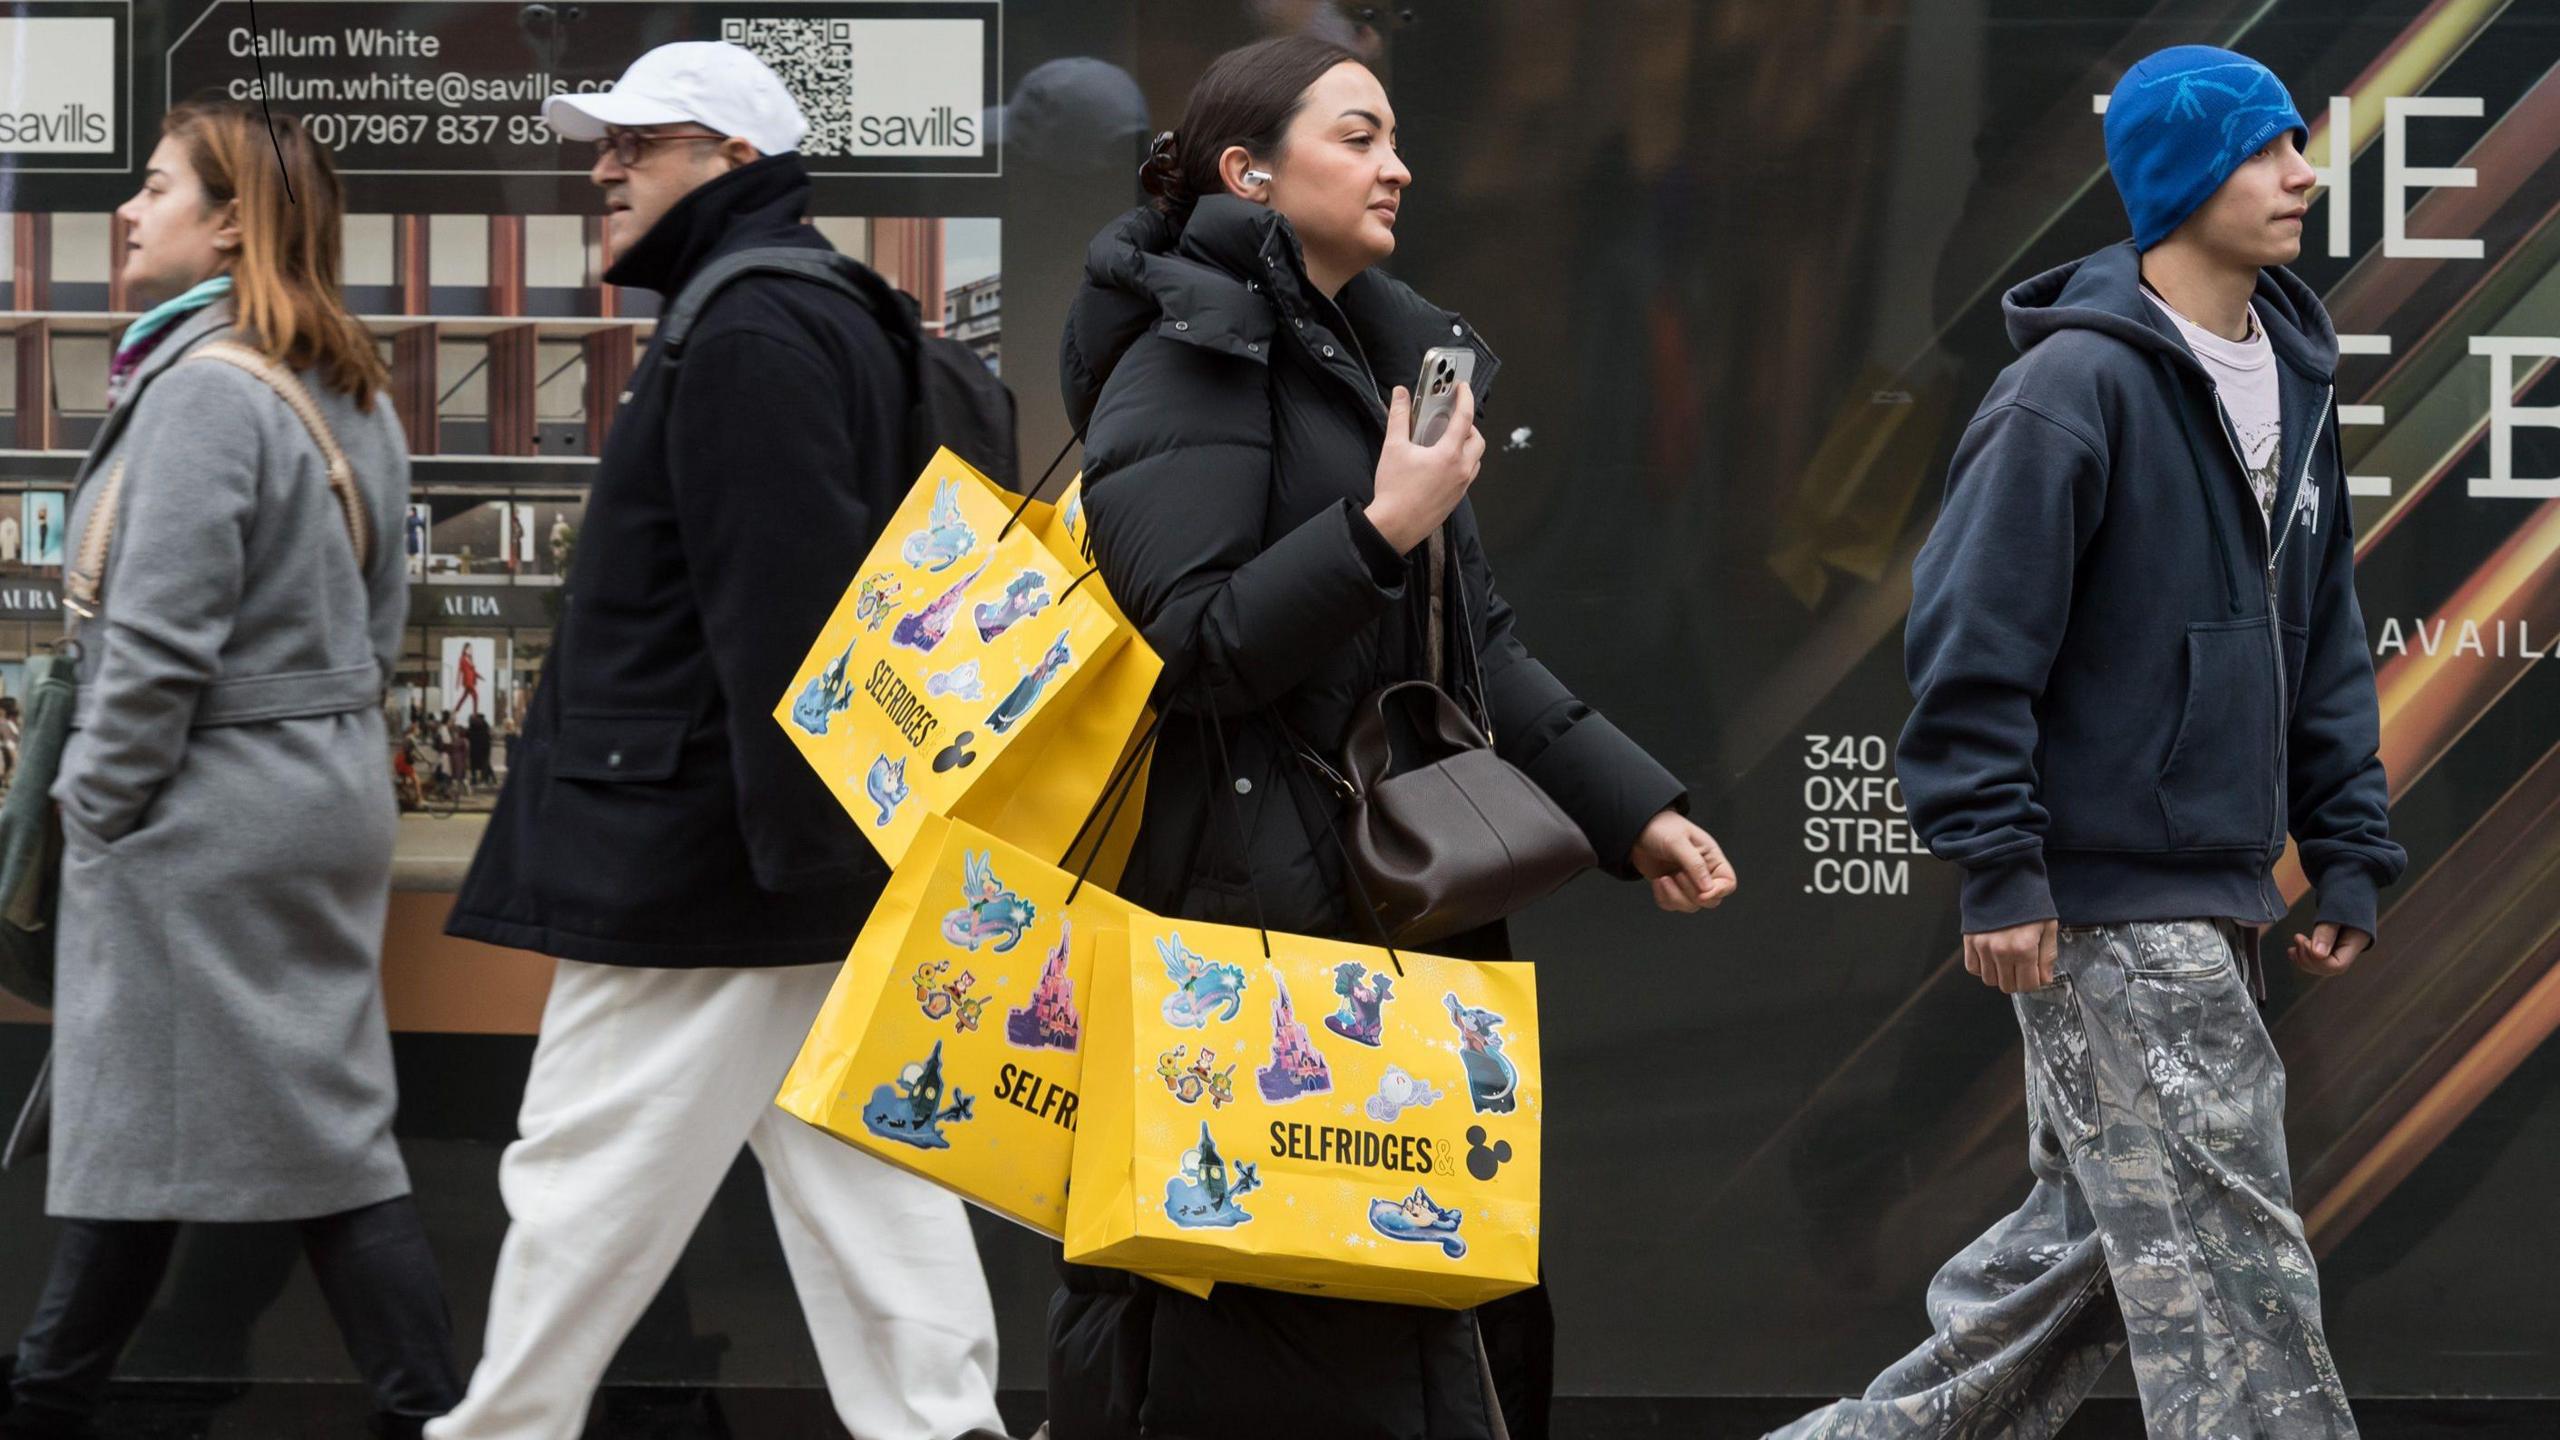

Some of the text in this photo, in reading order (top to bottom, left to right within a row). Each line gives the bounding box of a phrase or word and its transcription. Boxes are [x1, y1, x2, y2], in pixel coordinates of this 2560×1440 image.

[228, 27, 440, 57] Callum White
[0, 104, 106, 143] savills
[436, 115, 499, 145] 837
[508, 115, 563, 145] 93
[859, 106, 975, 147] savills
[2376, 617, 2560, 658] AVAIL
[1804, 735, 1887, 771] 340
[1803, 858, 1909, 895] .COM
[994, 1063, 1079, 1133] SELFR
